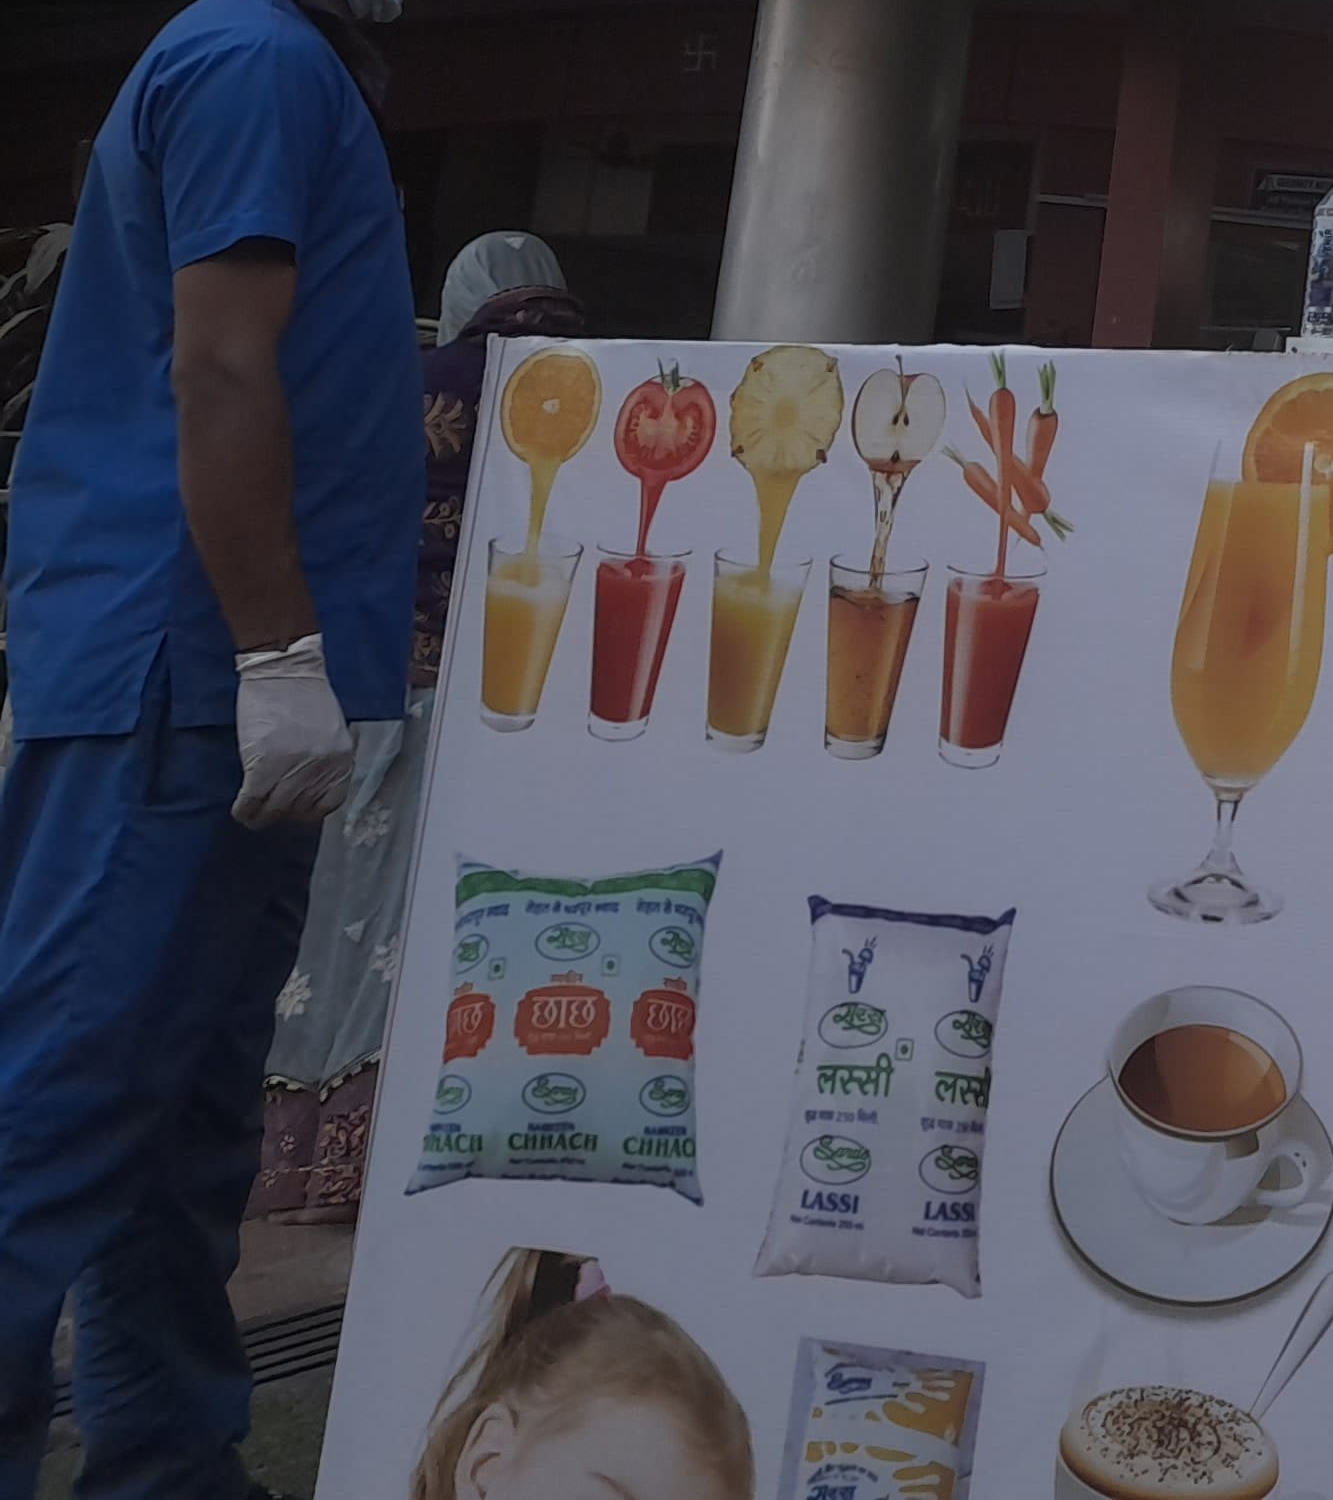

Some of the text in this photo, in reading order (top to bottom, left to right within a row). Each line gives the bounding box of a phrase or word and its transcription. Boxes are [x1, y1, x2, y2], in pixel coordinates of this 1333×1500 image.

[530, 995, 600, 1030] छाछ
[816, 1052, 895, 1098] लस्सी
[423, 1133, 484, 1153] HACH
[507, 1132, 599, 1152] CHHACH
[622, 1136, 696, 1159] CHHAC
[800, 1189, 861, 1214] LASSI
[923, 1200, 977, 1223] LASSI
